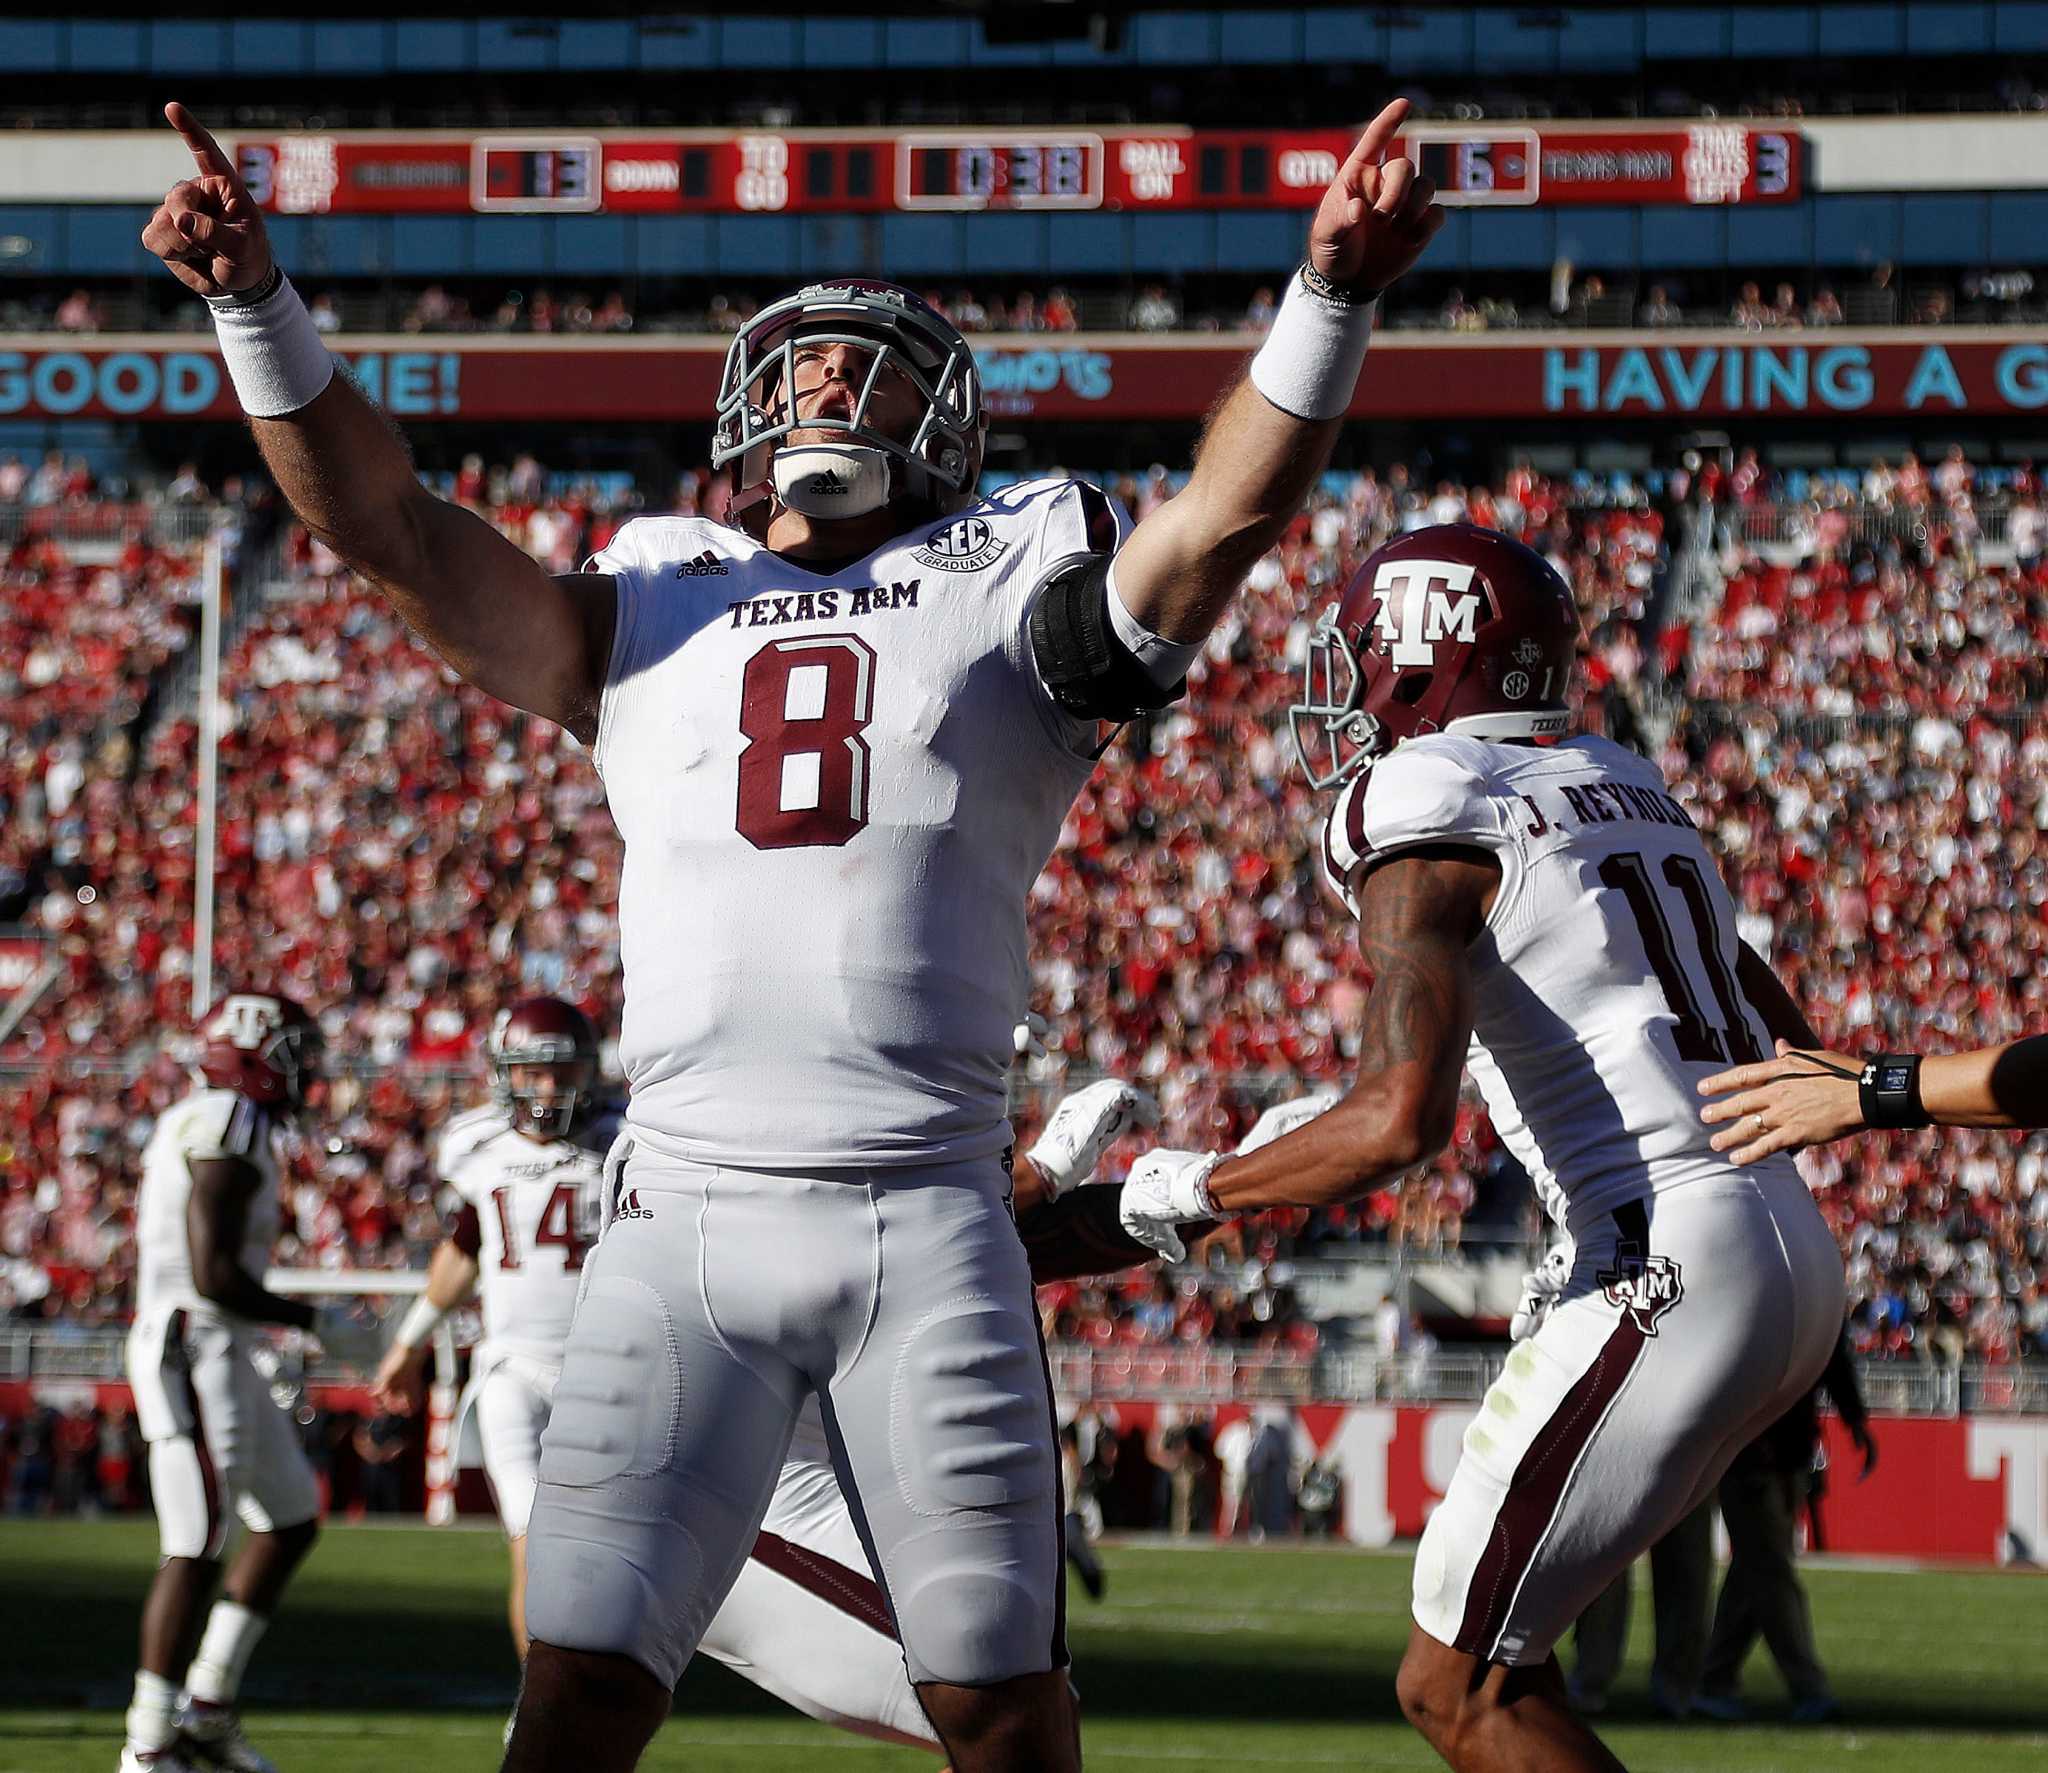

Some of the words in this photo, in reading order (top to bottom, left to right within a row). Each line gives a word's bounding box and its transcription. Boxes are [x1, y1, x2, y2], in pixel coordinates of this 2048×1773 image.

[607, 159, 680, 193] DOWN
[1757, 135, 1790, 194] 3
[0, 352, 220, 415] GOOD
[333, 353, 461, 415] ME!
[1542, 346, 1876, 412] HAVING
[1905, 345, 1968, 410] A
[809, 486, 848, 495] adidas
[924, 551, 995, 570] GRADUATE
[931, 520, 986, 555] SEC
[677, 566, 729, 579] adidas
[728, 591, 839, 629] TEXAS
[849, 579, 921, 617] A&M
[735, 632, 878, 850] 8
[1521, 795, 1562, 838] J.
[1600, 852, 1766, 1065] 11
[491, 1182, 590, 1272] 14
